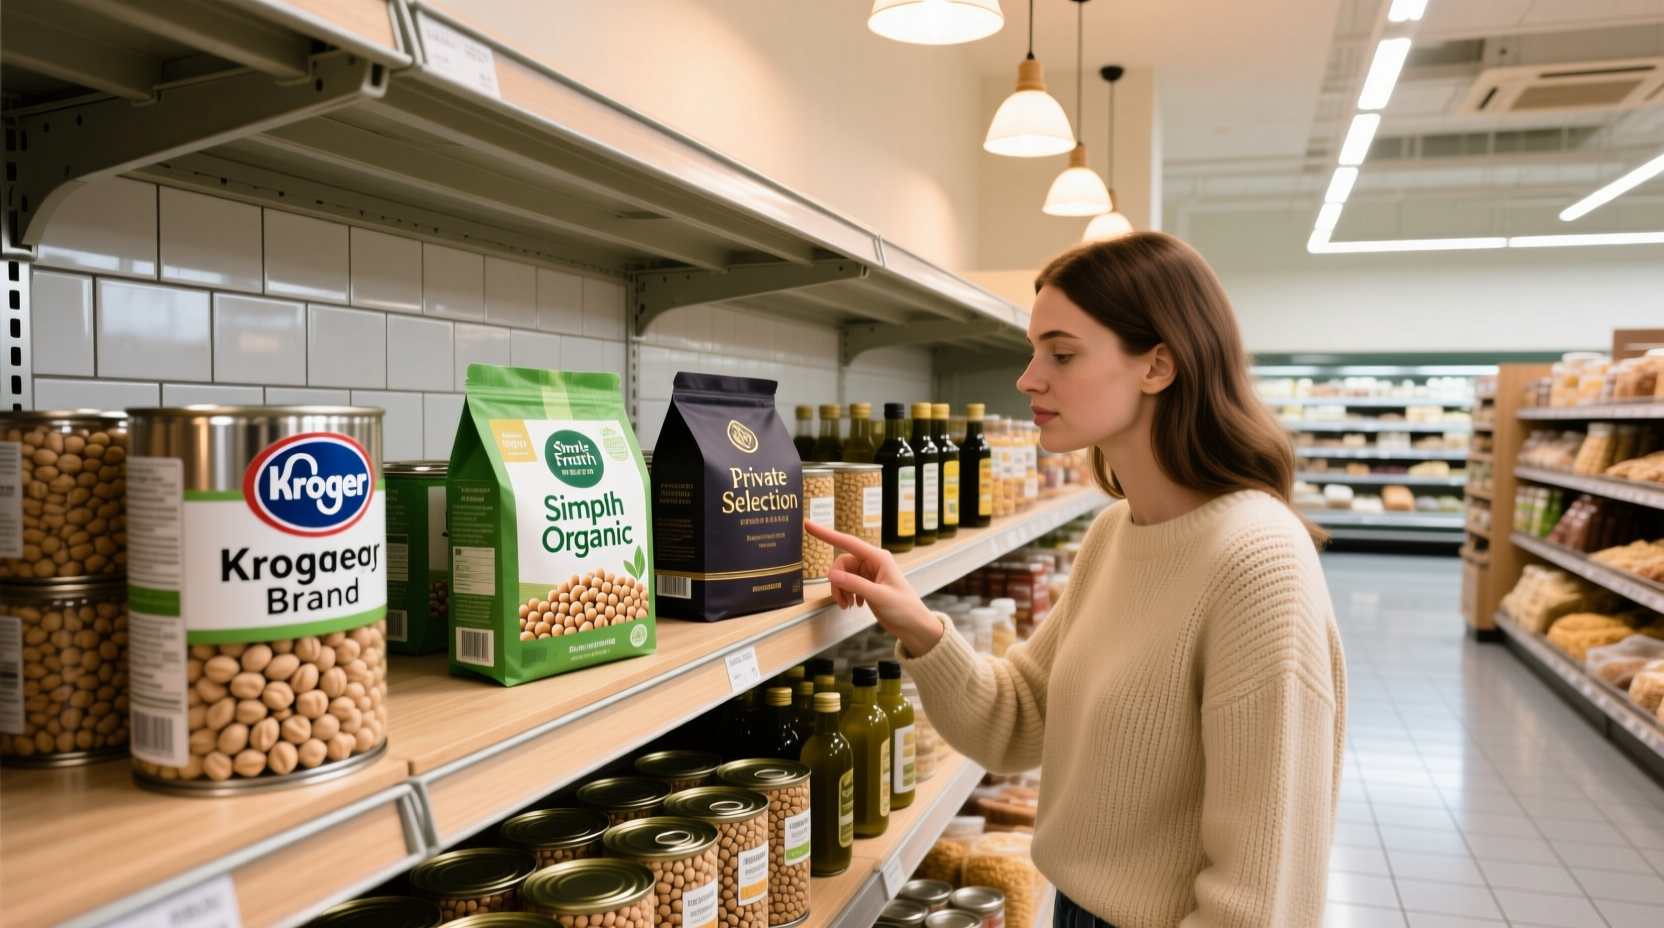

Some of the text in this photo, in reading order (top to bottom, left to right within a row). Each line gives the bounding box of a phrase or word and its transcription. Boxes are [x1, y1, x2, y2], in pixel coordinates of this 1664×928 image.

[269, 453, 367, 516] Kroger
[729, 466, 788, 489] Private
[722, 489, 798, 515] Selection
[542, 520, 633, 559] Organic
[267, 577, 359, 615] Brand
